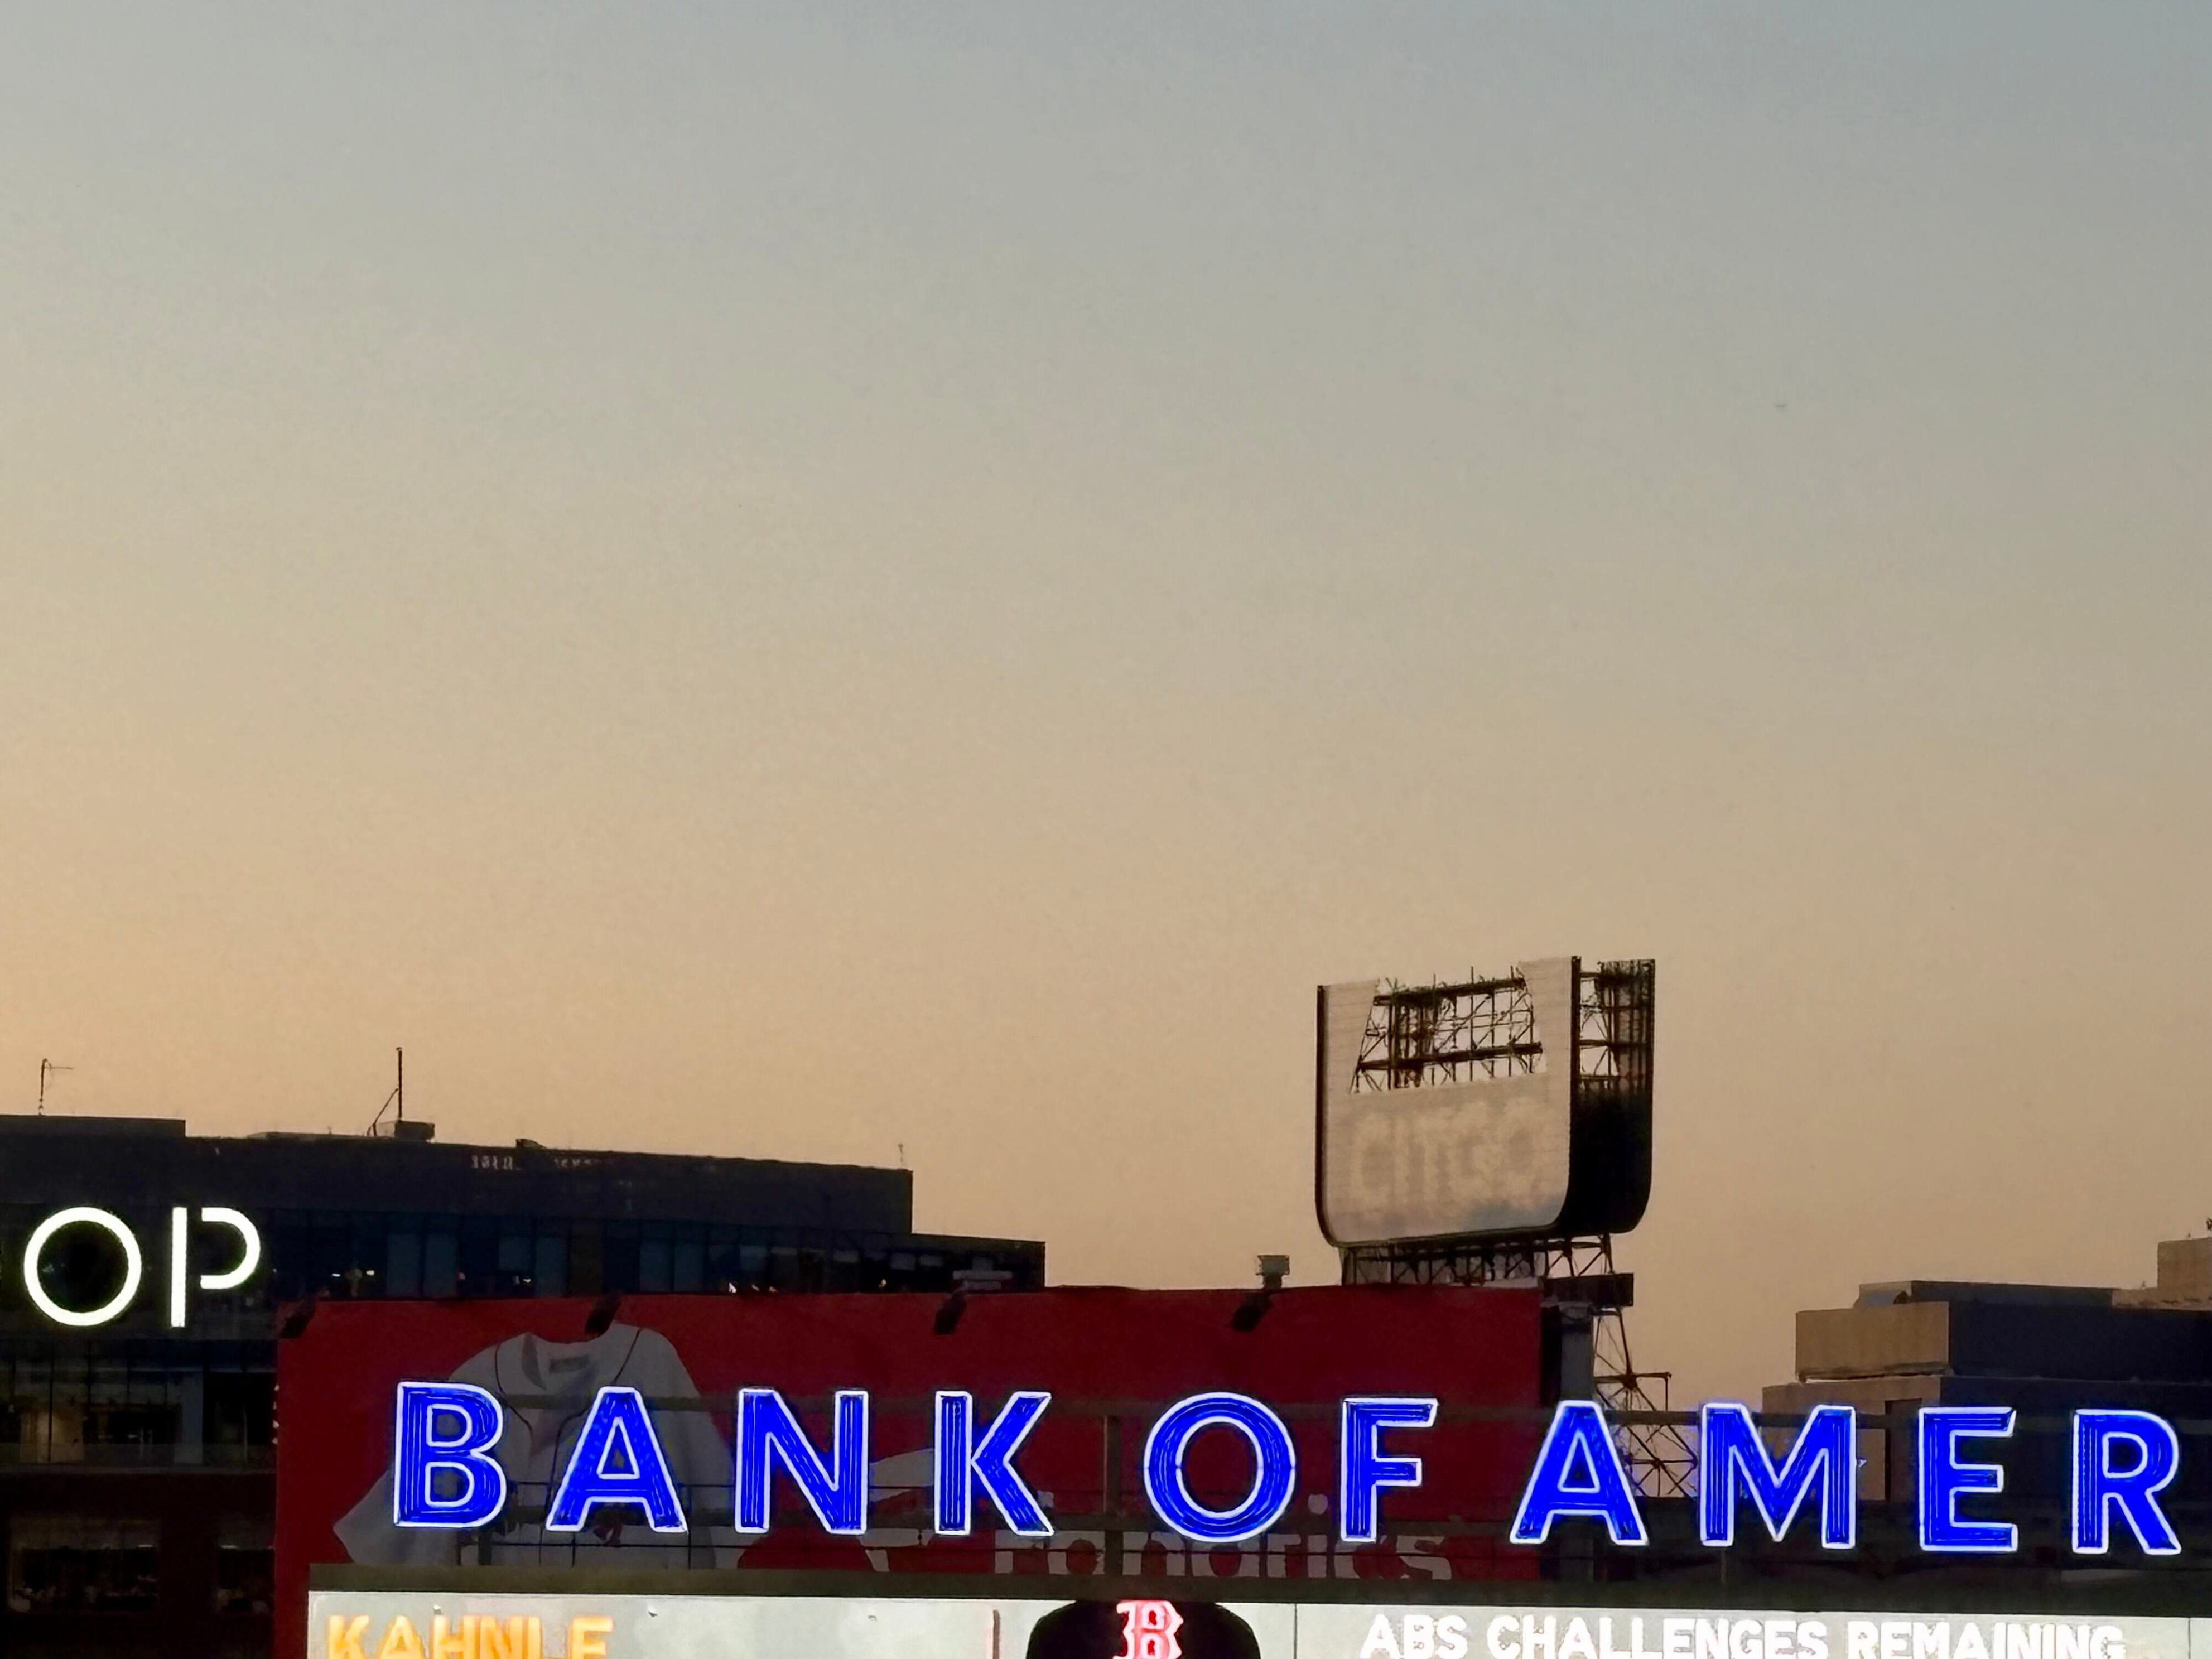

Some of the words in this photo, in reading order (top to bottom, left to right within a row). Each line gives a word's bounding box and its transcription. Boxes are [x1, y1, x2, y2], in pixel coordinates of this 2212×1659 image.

[392, 1380, 1053, 1537] BANK
[1142, 1390, 1439, 1545] OF
[1509, 1398, 2182, 1557] AMER
[1360, 1613, 1468, 1659] ABS
[1486, 1615, 1828, 1659] CHALLENGES
[1847, 1619, 2127, 1659] REMAINING
